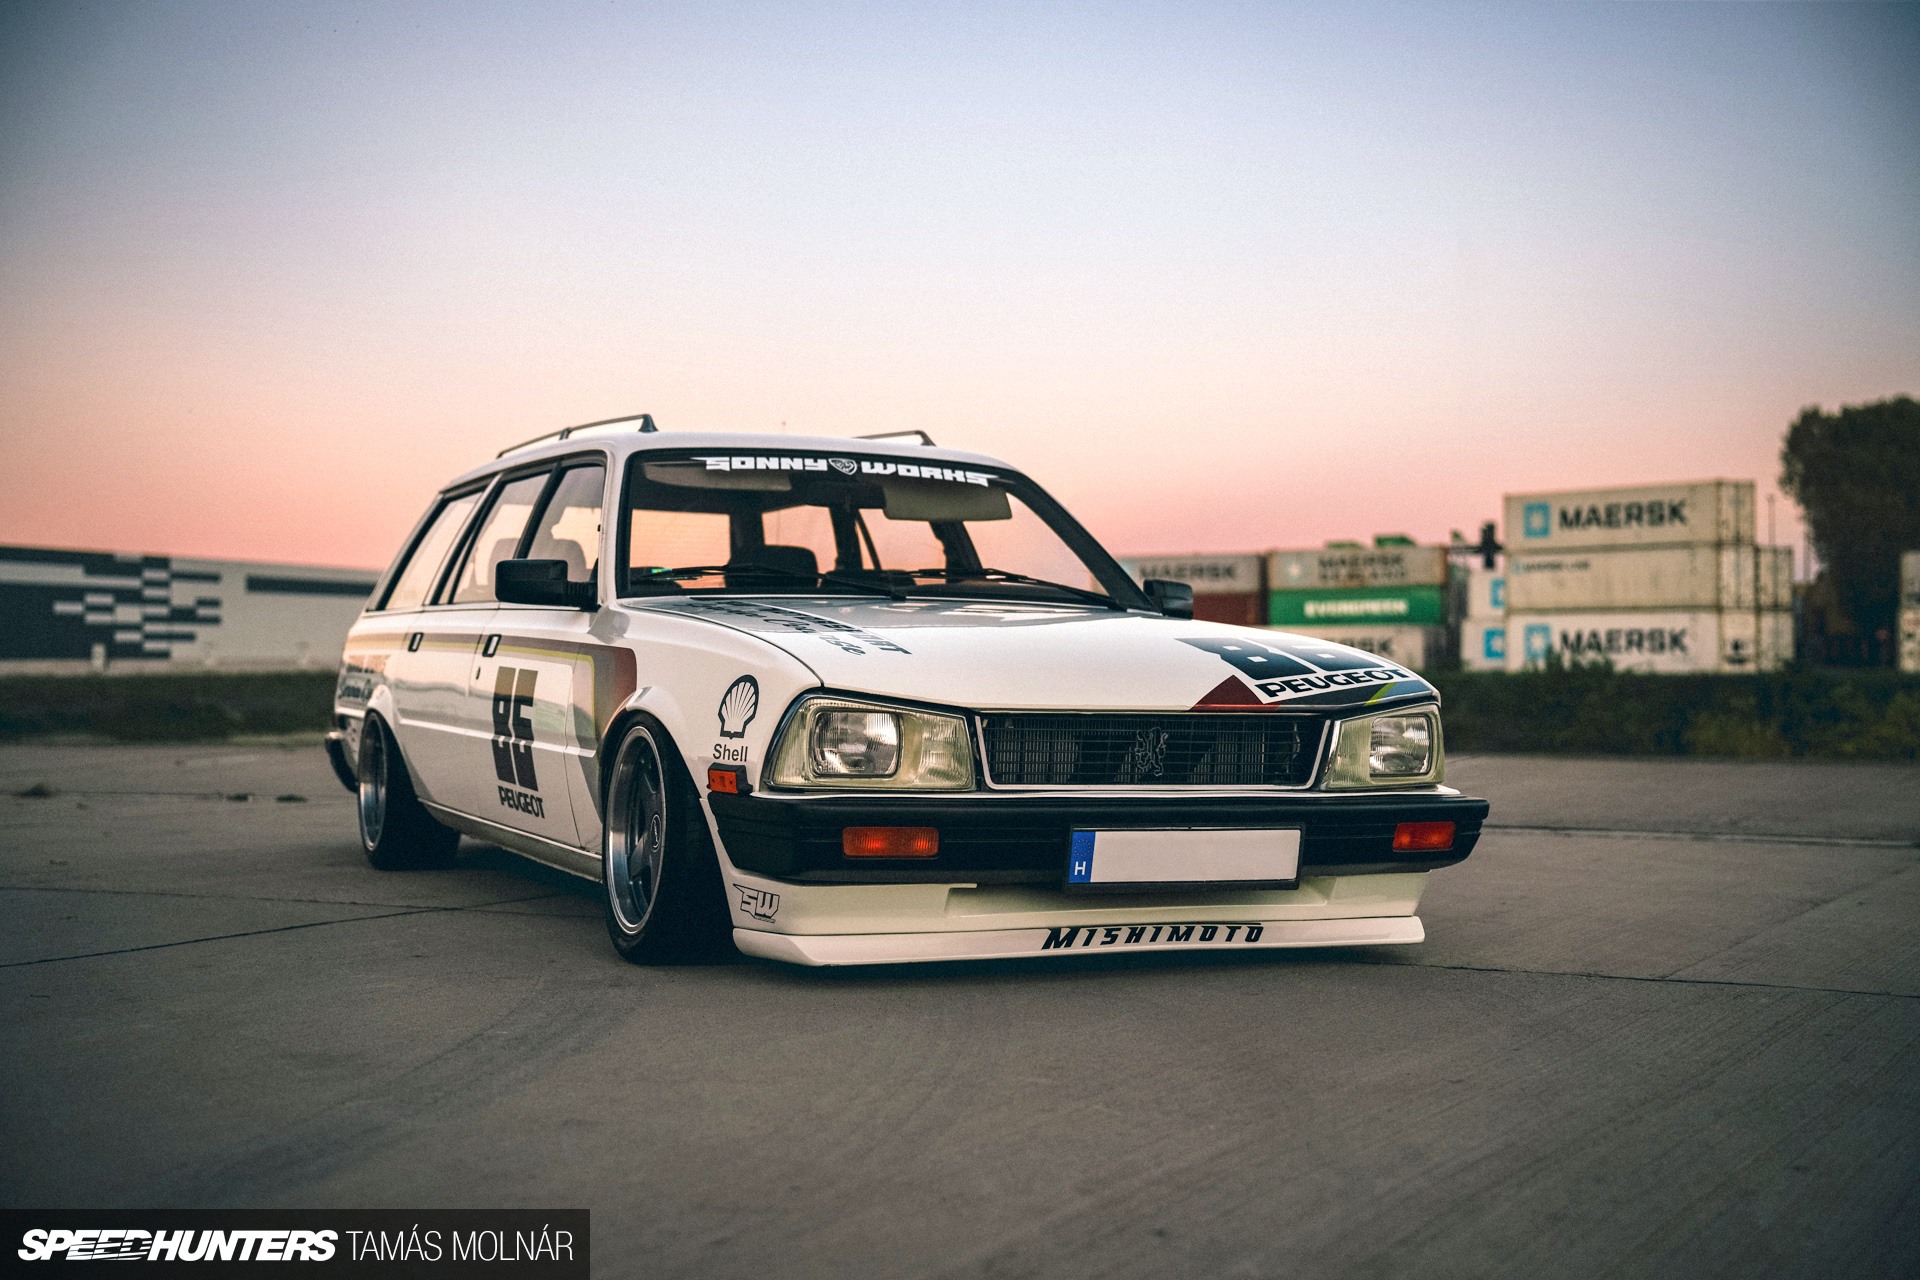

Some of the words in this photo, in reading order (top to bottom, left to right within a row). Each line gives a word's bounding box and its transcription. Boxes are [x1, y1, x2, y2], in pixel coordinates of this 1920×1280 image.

[690, 457, 828, 471] SONNY
[861, 461, 998, 487] WORKS
[1559, 499, 1688, 530] MAERSK
[1139, 562, 1236, 581] MAERSK
[1560, 627, 1688, 656] MAERSK
[1254, 669, 1411, 698] PEUGEOT
[712, 743, 748, 762] Shell
[498, 785, 545, 819] PEUGEOT
[1074, 861, 1086, 876] H
